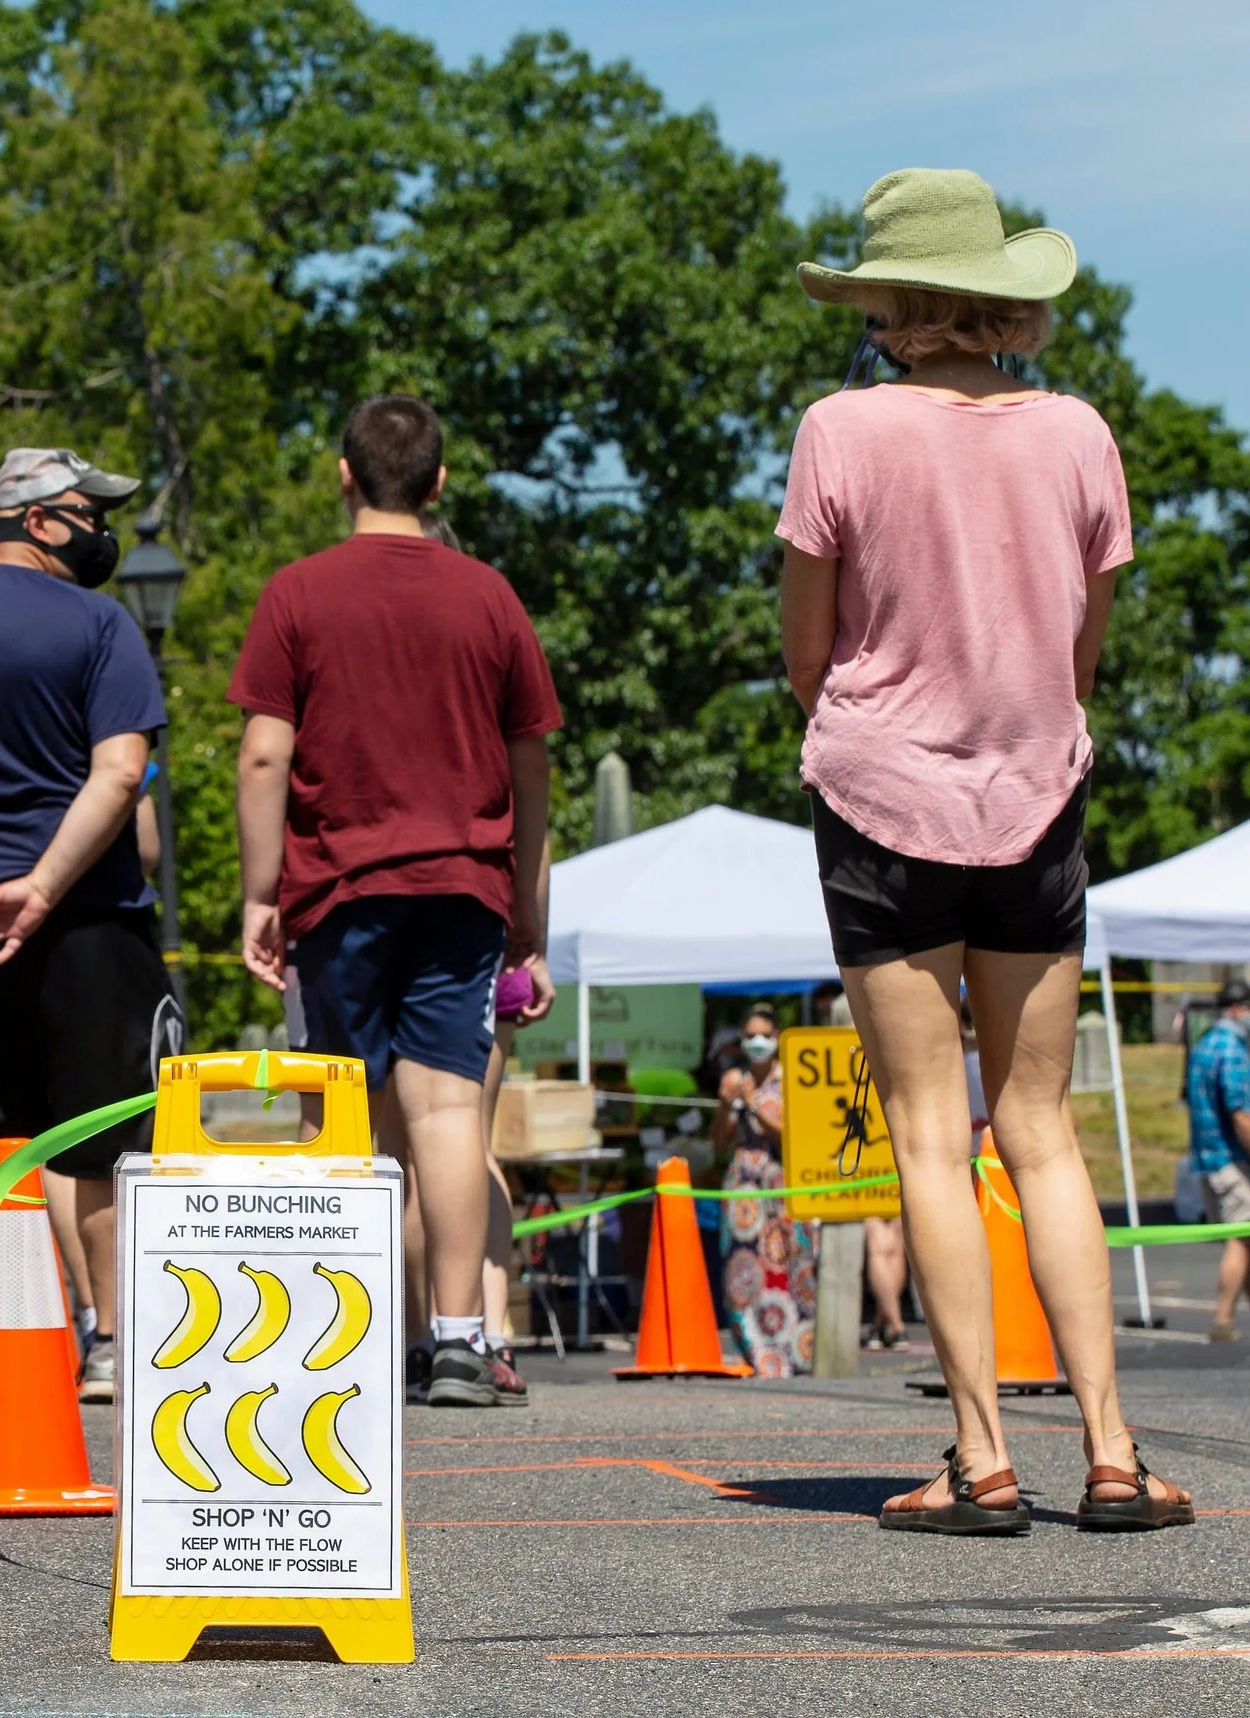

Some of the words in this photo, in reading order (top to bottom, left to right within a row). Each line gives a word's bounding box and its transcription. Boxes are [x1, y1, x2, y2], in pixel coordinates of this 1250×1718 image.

[797, 1047, 870, 1088] SLO
[800, 1165, 896, 1184] CHILDRE
[186, 1194, 219, 1213] NO
[227, 1195, 342, 1214] BUNCHING
[167, 1225, 187, 1238] AT
[191, 1225, 220, 1238] THE
[225, 1225, 294, 1239] FARMERS
[299, 1226, 359, 1239] MARKET
[192, 1508, 255, 1528] SHOP
[262, 1508, 290, 1528] 'N'
[298, 1509, 331, 1528] GO
[181, 1537, 218, 1550] KEEP
[223, 1537, 260, 1551] WITH
[265, 1538, 294, 1551] THE
[299, 1538, 342, 1552] FLOW
[165, 1557, 208, 1571] SHOP
[212, 1558, 264, 1571] ALONE
[269, 1558, 282, 1572] IF
[287, 1559, 358, 1572] POSSIBLE
